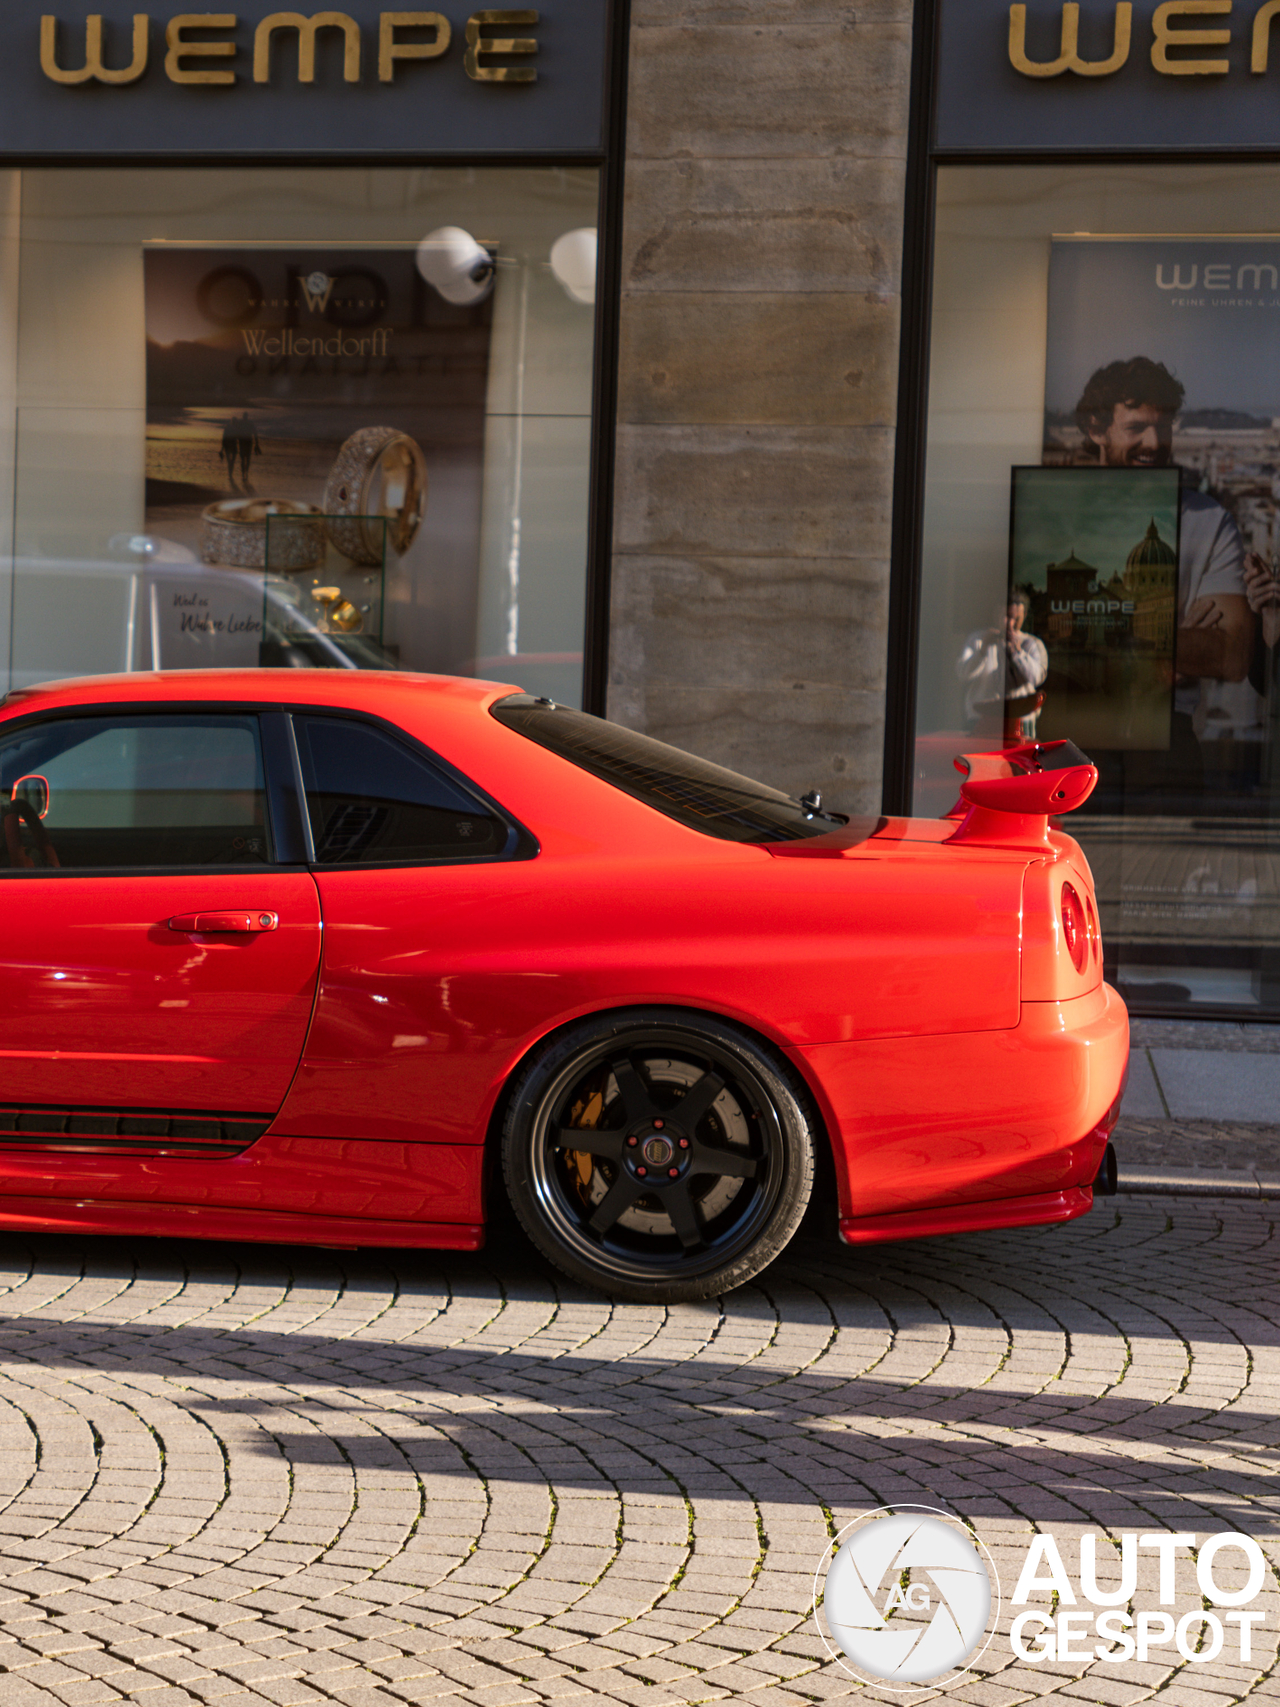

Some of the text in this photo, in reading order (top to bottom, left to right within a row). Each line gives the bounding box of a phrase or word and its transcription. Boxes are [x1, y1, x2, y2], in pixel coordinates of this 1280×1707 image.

[40, 9, 539, 84] WEMPE
[1008, 0, 1280, 77] WE
[240, 328, 394, 357] Wellendorff
[1051, 600, 1135, 614] WEMPE
[228, 612, 263, 633] Liebe
